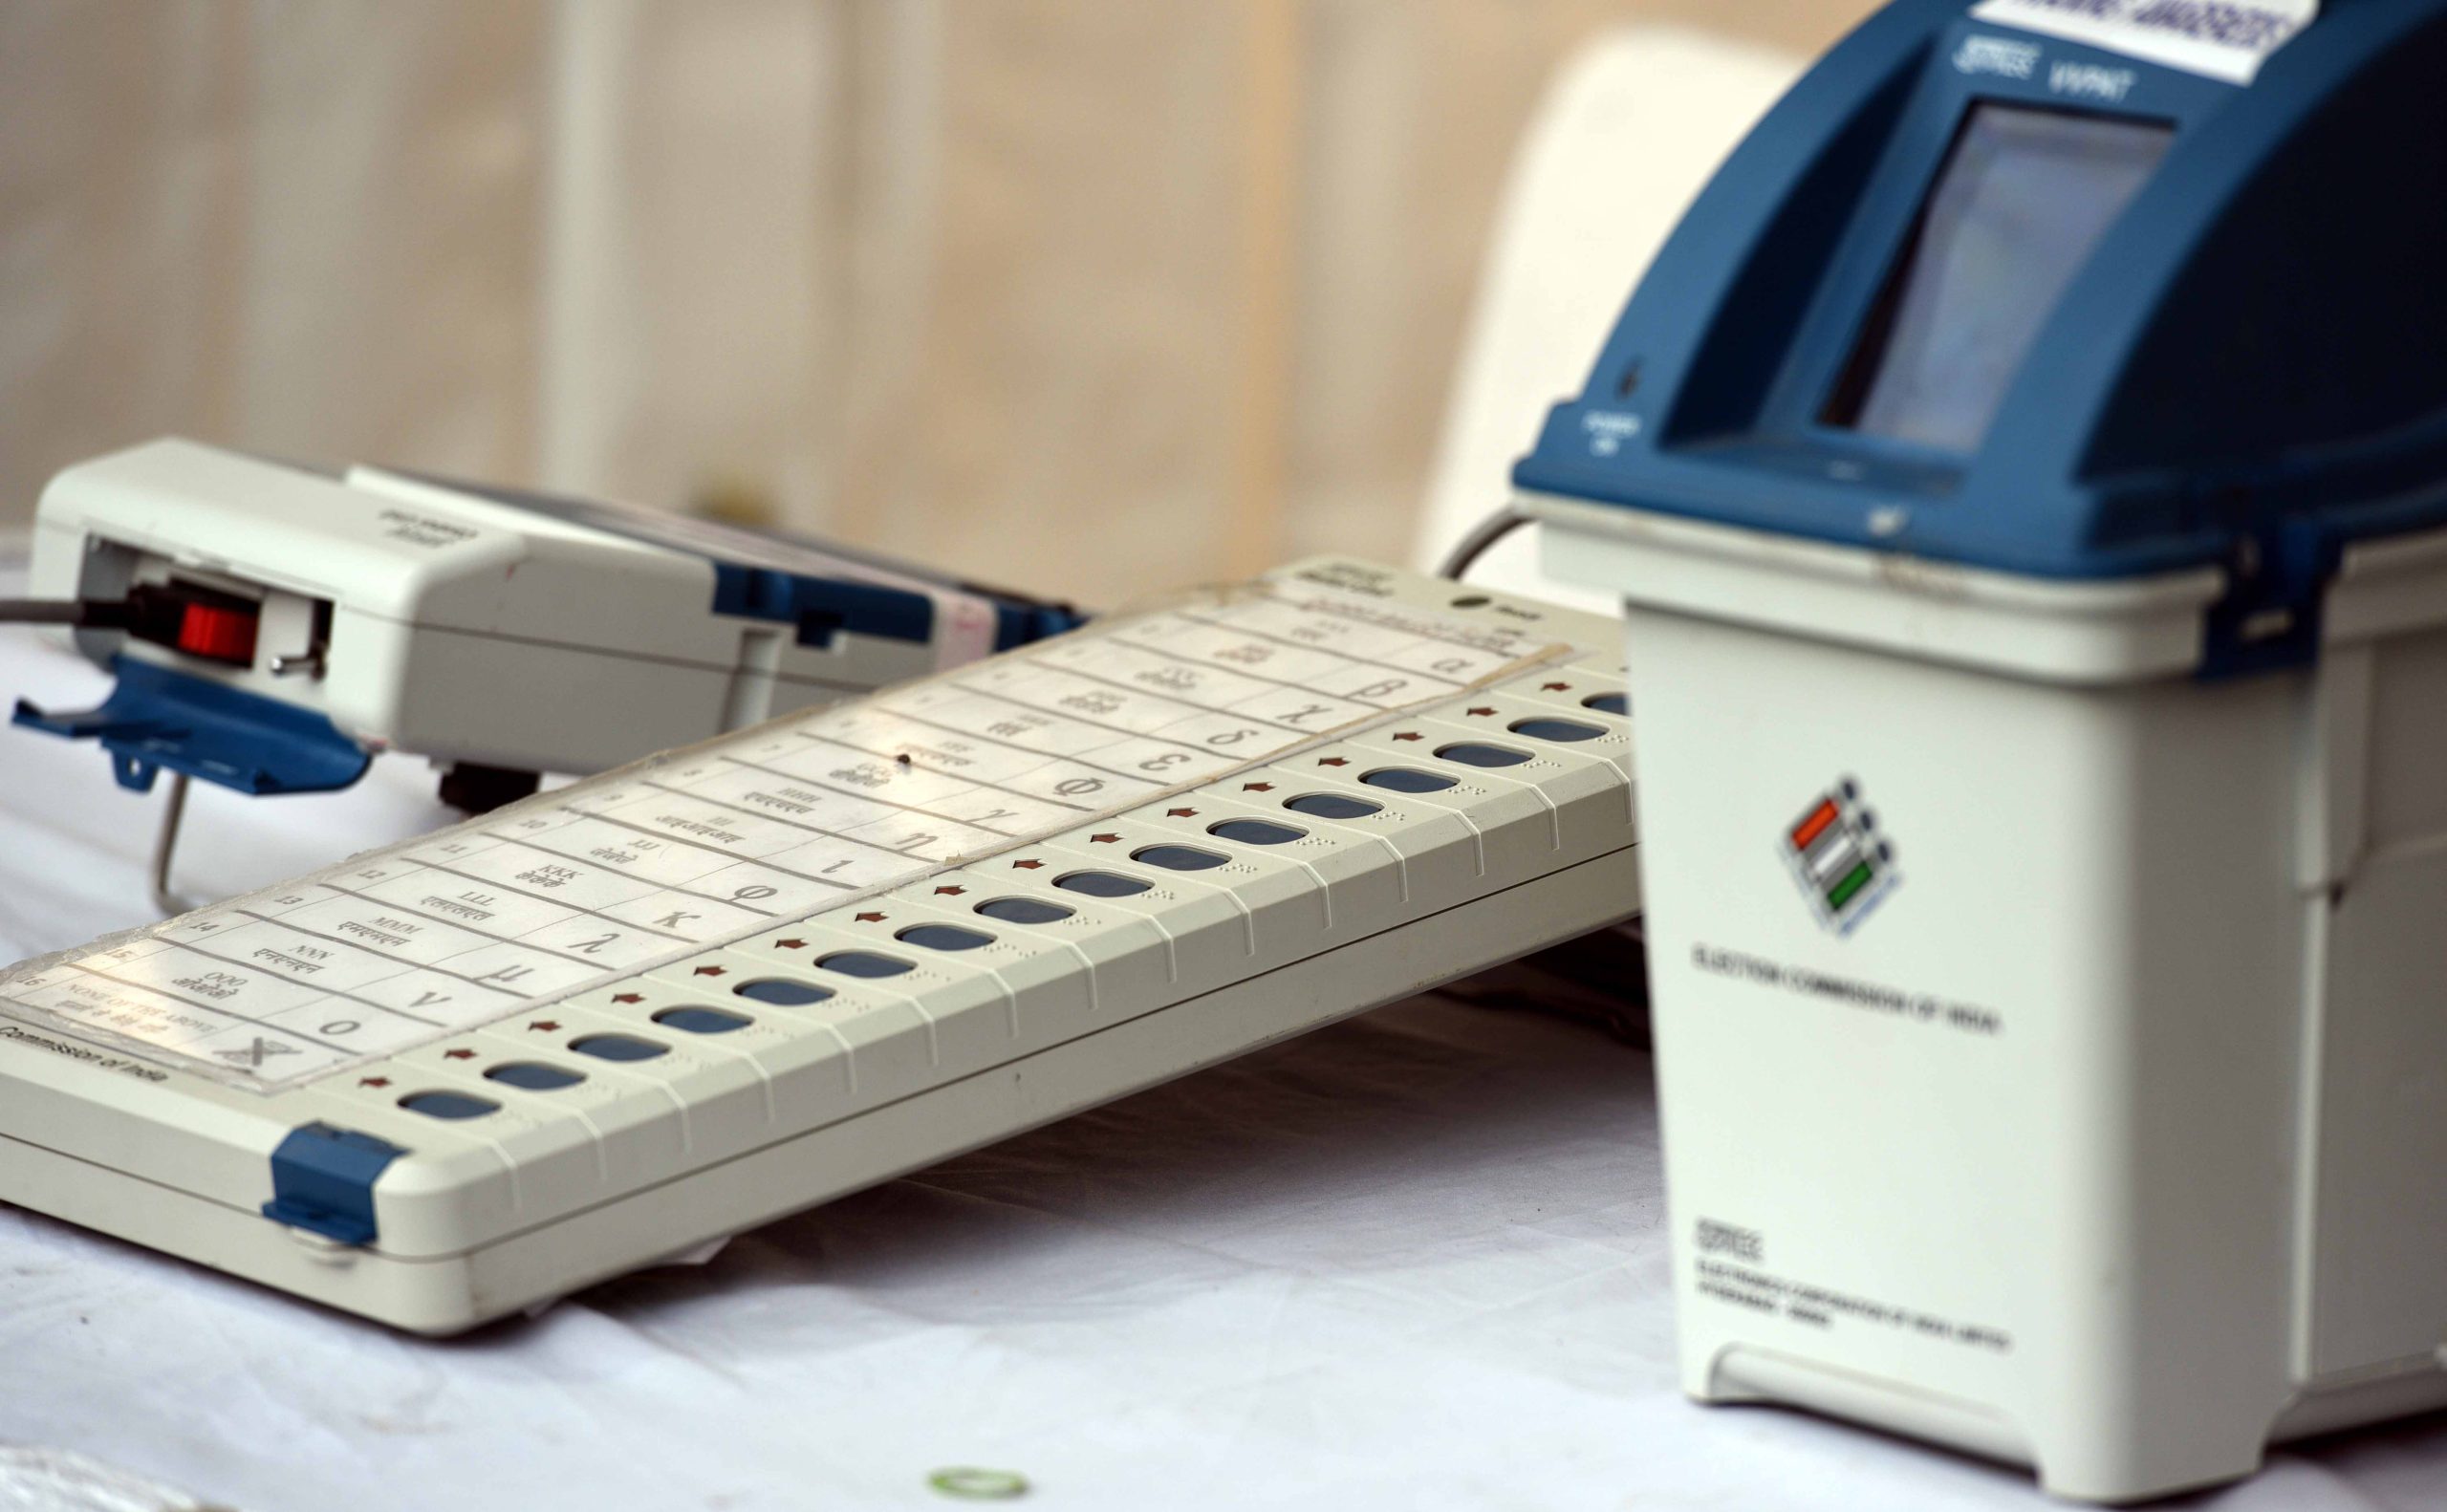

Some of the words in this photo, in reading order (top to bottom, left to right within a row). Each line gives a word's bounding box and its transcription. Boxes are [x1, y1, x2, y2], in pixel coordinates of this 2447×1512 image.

[518, 819, 548, 829] 10
[438, 844, 467, 853] 11
[627, 839, 660, 850] JJJ
[357, 870, 386, 879] 12
[532, 865, 584, 879] KKK
[515, 871, 566, 887] केकेके
[273, 896, 304, 904] 13
[457, 892, 496, 906] LLL
[188, 922, 220, 932] 14
[367, 918, 423, 934] MMM
[106, 948, 134, 960] 15
[289, 944, 335, 961] NNN
[16, 975, 47, 986] 16
[68, 983, 107, 1001] NONE
[166, 1014, 219, 1032] ABOVE
[0, 1026, 102, 1060] Commission
[122, 1064, 168, 1081] India
